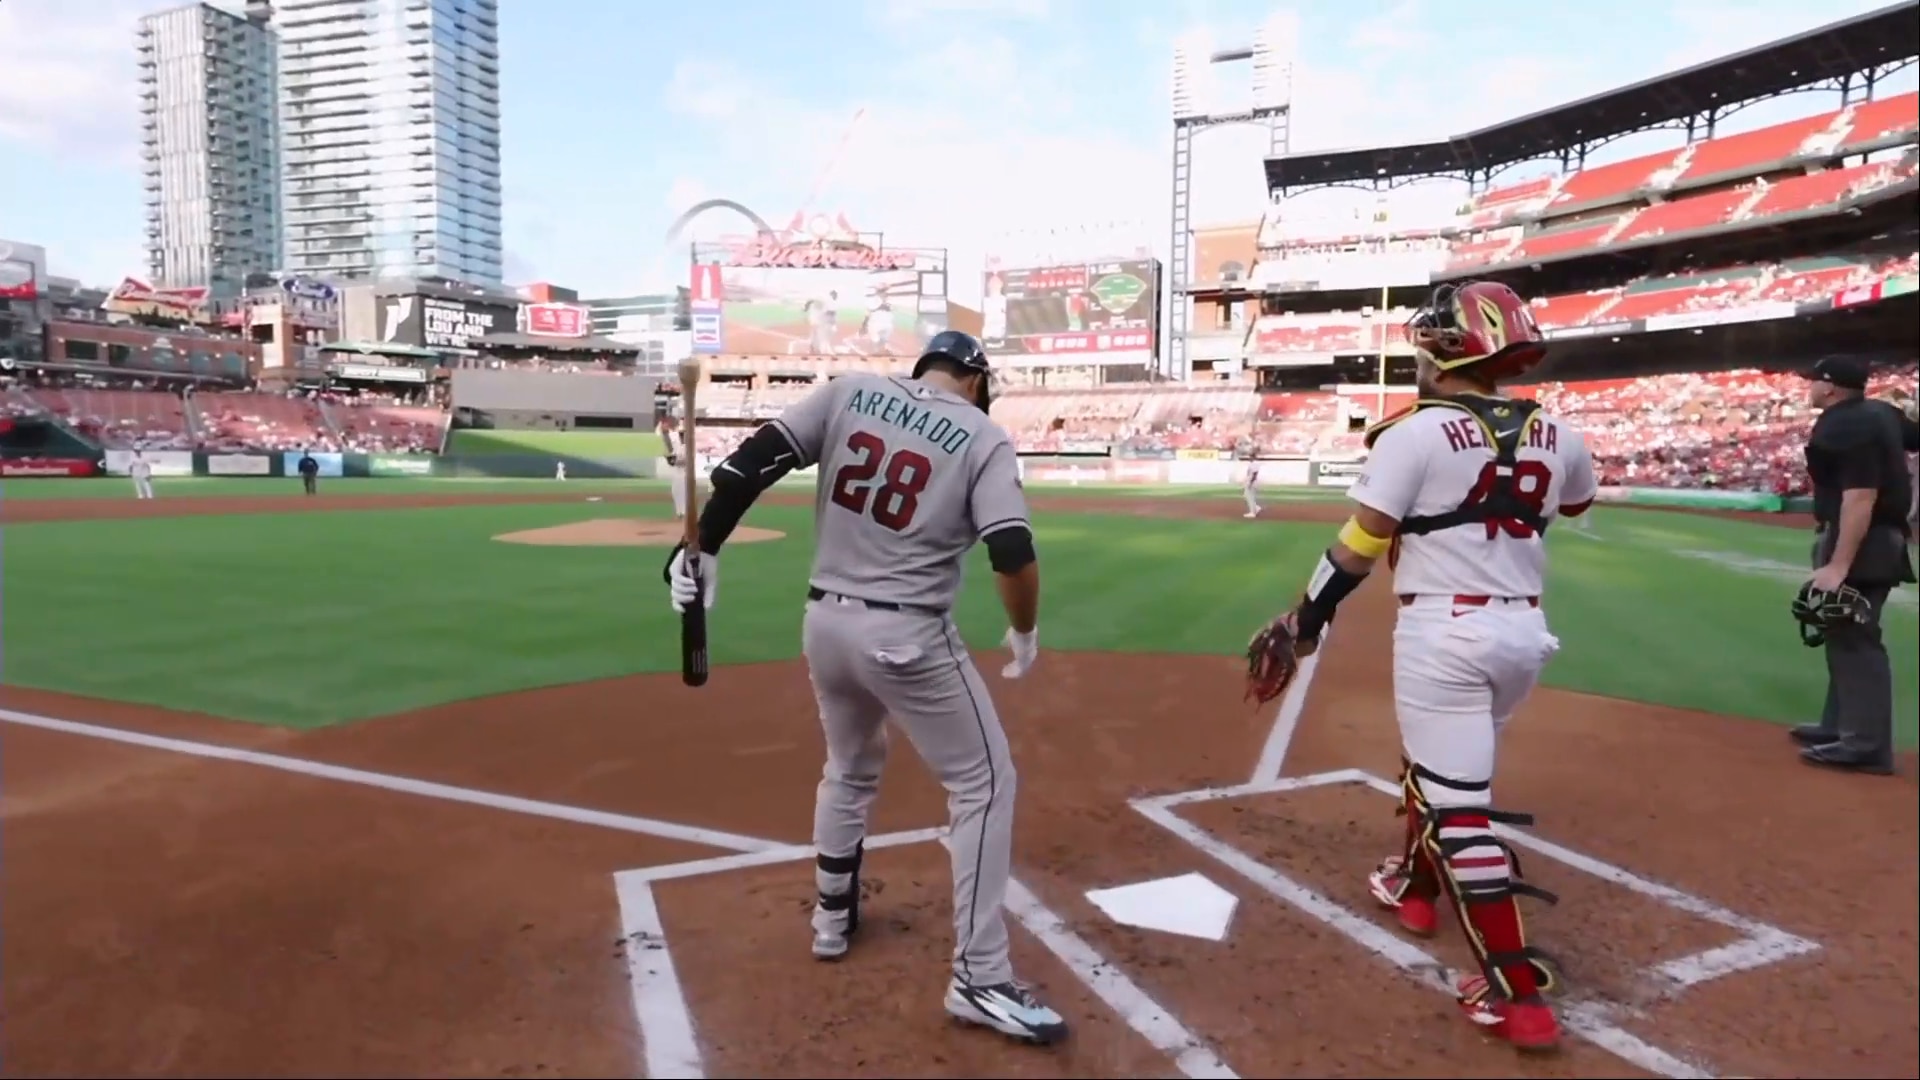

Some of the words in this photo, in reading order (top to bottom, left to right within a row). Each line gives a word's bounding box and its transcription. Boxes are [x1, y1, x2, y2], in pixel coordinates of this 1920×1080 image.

[425, 307, 464, 323] FROM
[466, 312, 493, 327] THE
[425, 320, 452, 333] LOU
[455, 323, 484, 337] AND
[848, 389, 970, 454] ARENADO
[1440, 417, 1557, 454] HERA
[832, 430, 932, 532] 28
